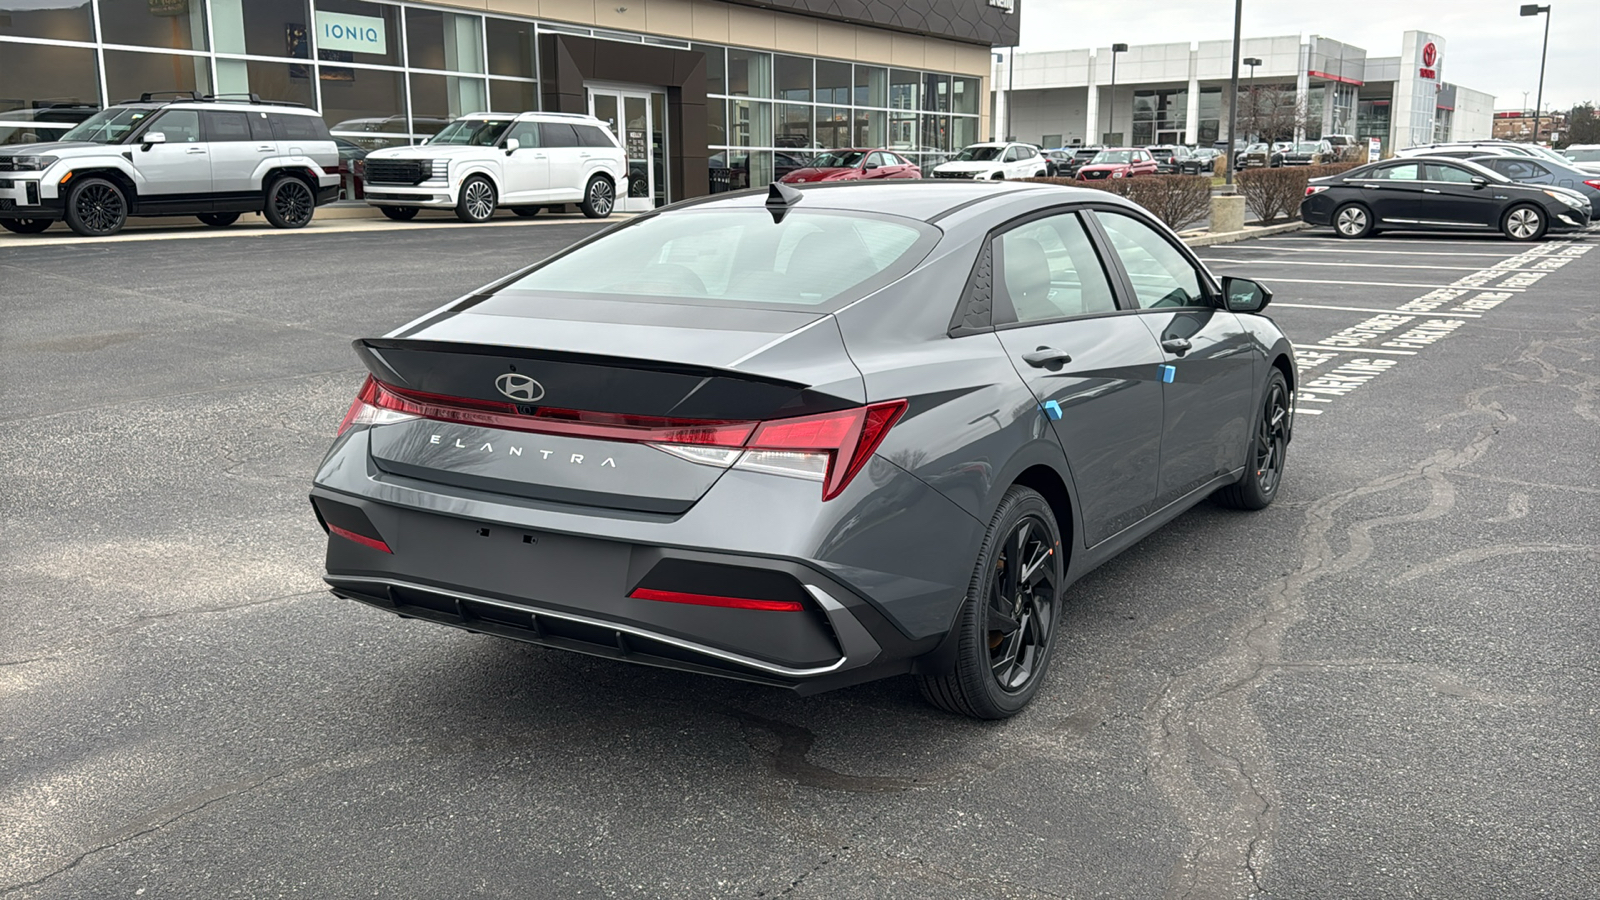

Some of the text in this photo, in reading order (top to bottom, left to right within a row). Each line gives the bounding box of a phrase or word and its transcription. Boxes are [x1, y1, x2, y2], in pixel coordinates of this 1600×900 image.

[325, 24, 378, 43] IONIQ
[1381, 319, 1466, 349] PARKING
[1296, 358, 1398, 403] PARKING
[429, 435, 617, 469] ELANTRA
